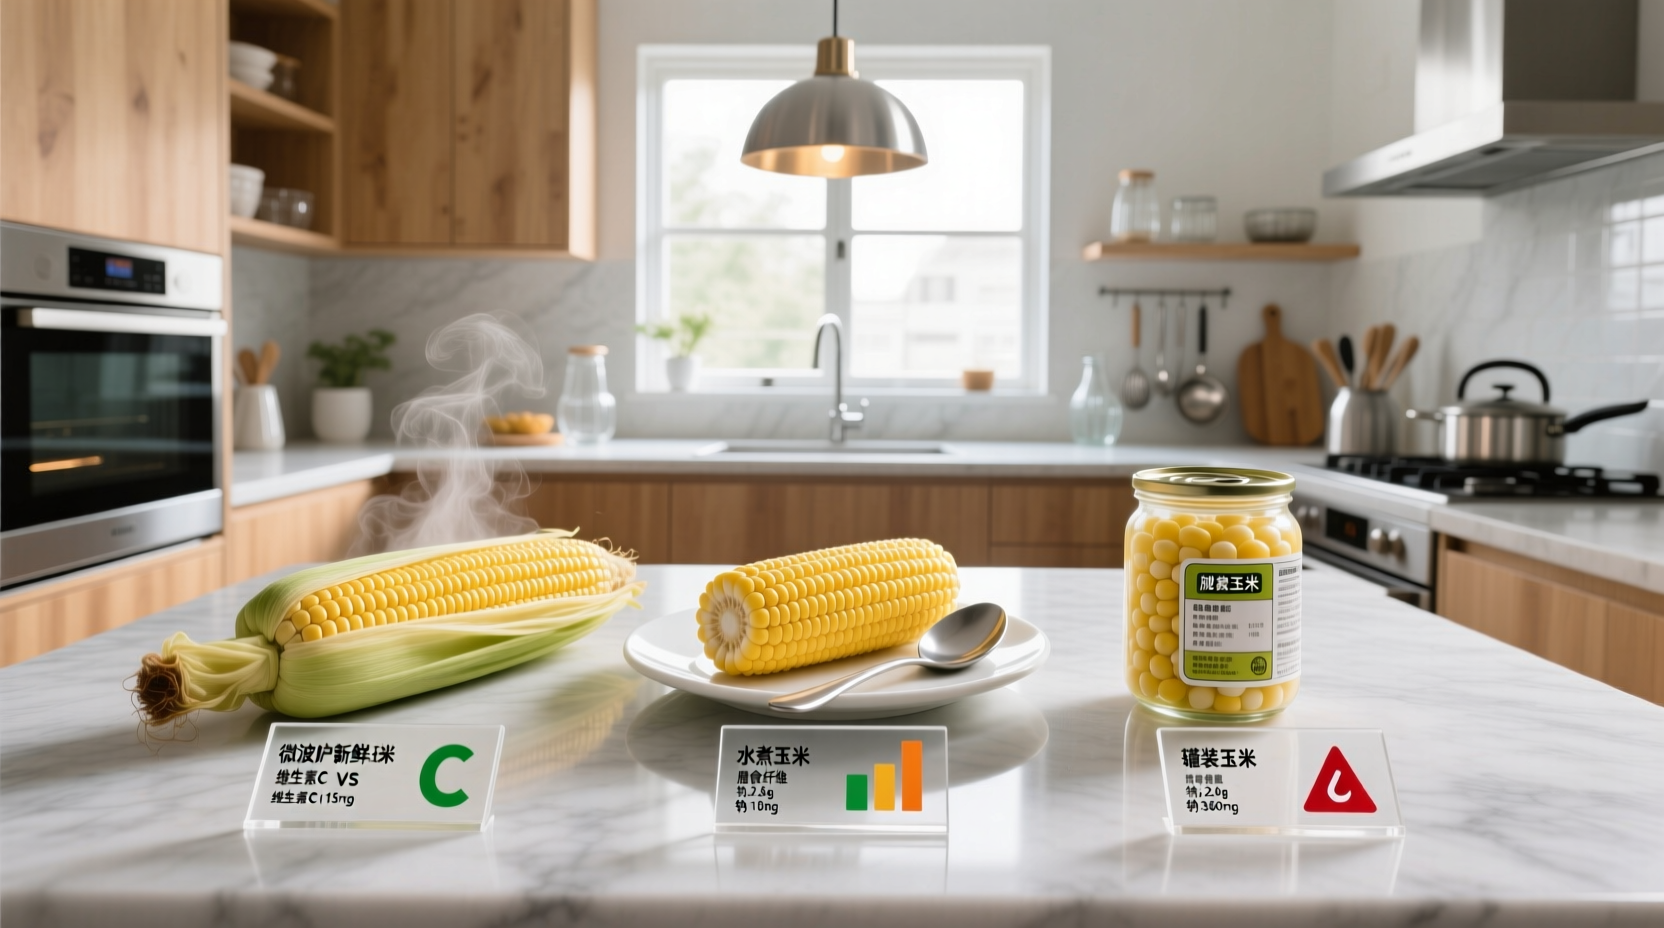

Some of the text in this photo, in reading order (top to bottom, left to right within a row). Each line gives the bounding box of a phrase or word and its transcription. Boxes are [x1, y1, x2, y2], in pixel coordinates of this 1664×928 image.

[736, 745, 811, 767] 水煮玉米
[1181, 746, 1258, 768] 罐装玉米
[337, 771, 360, 787] VS
